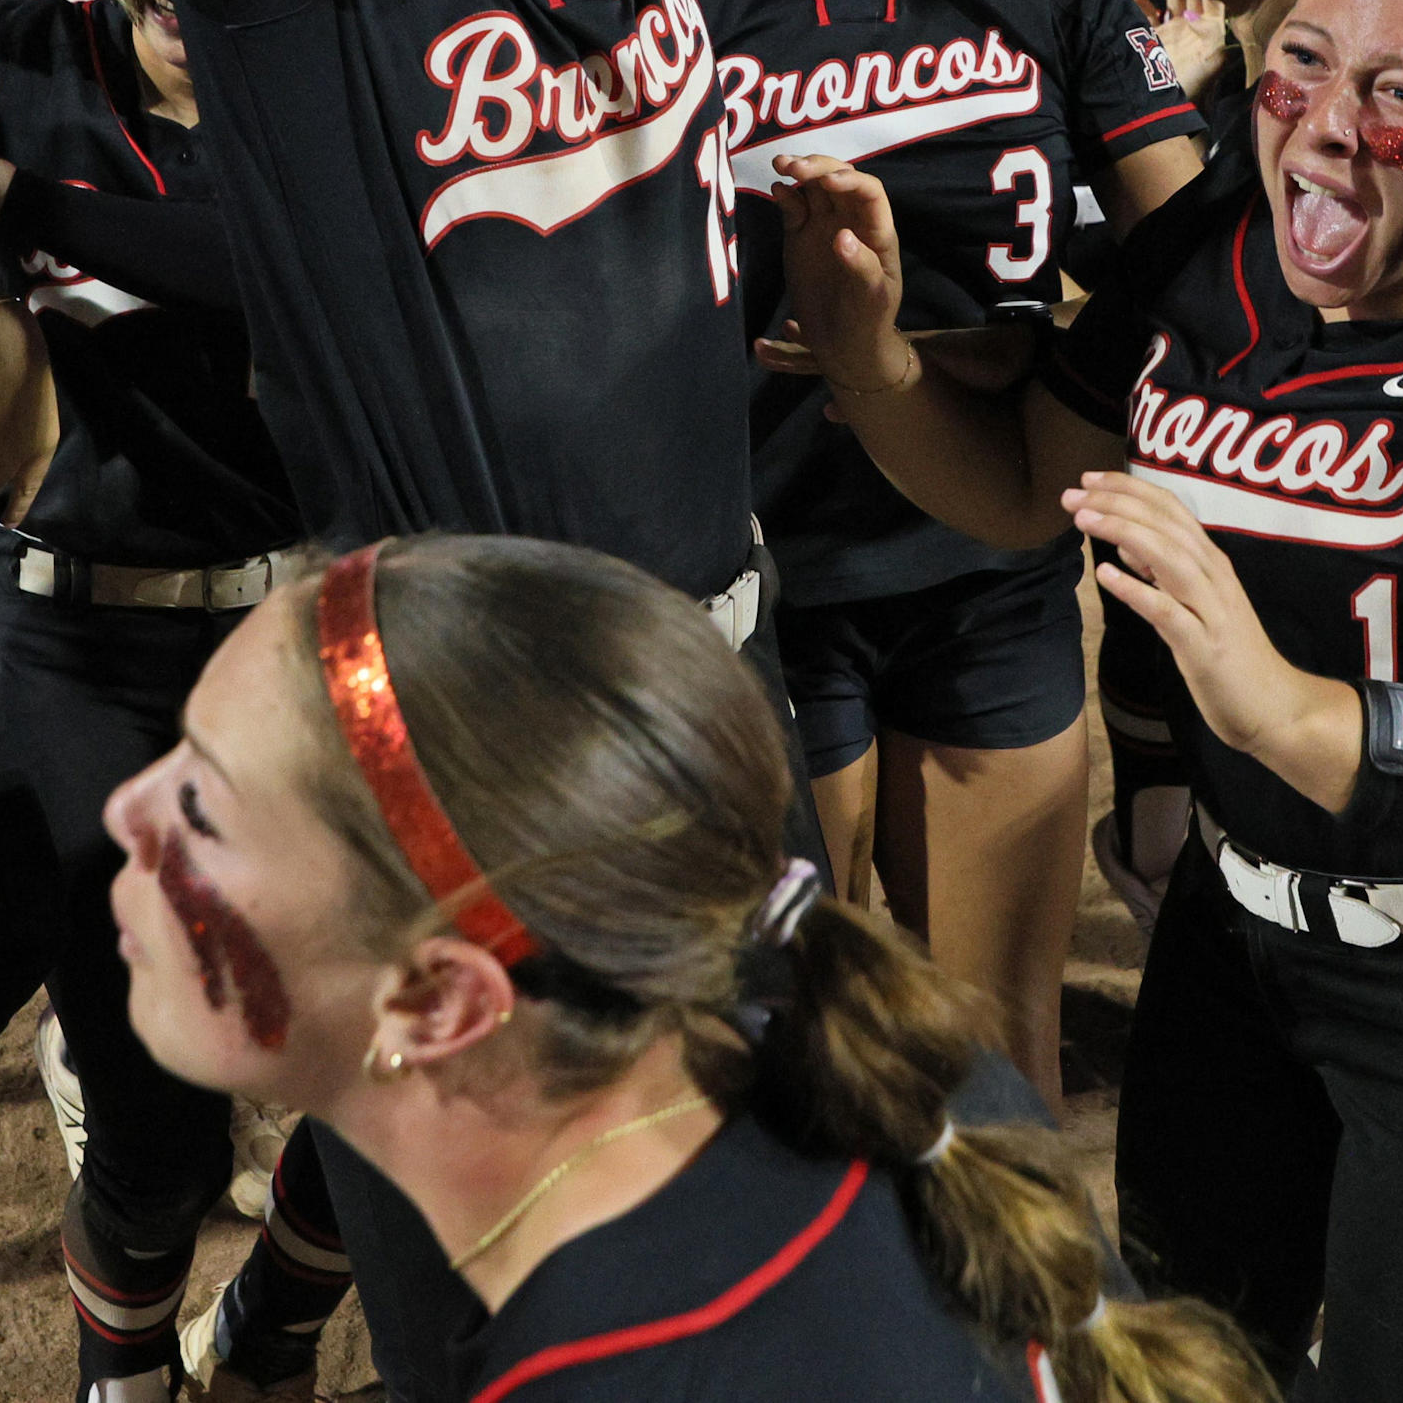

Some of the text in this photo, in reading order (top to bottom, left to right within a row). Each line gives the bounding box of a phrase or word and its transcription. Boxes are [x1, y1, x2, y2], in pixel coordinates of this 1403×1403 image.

[716, 26, 1034, 152] Broncos
[985, 145, 1053, 283] 3
[1351, 573, 1398, 682] 1
